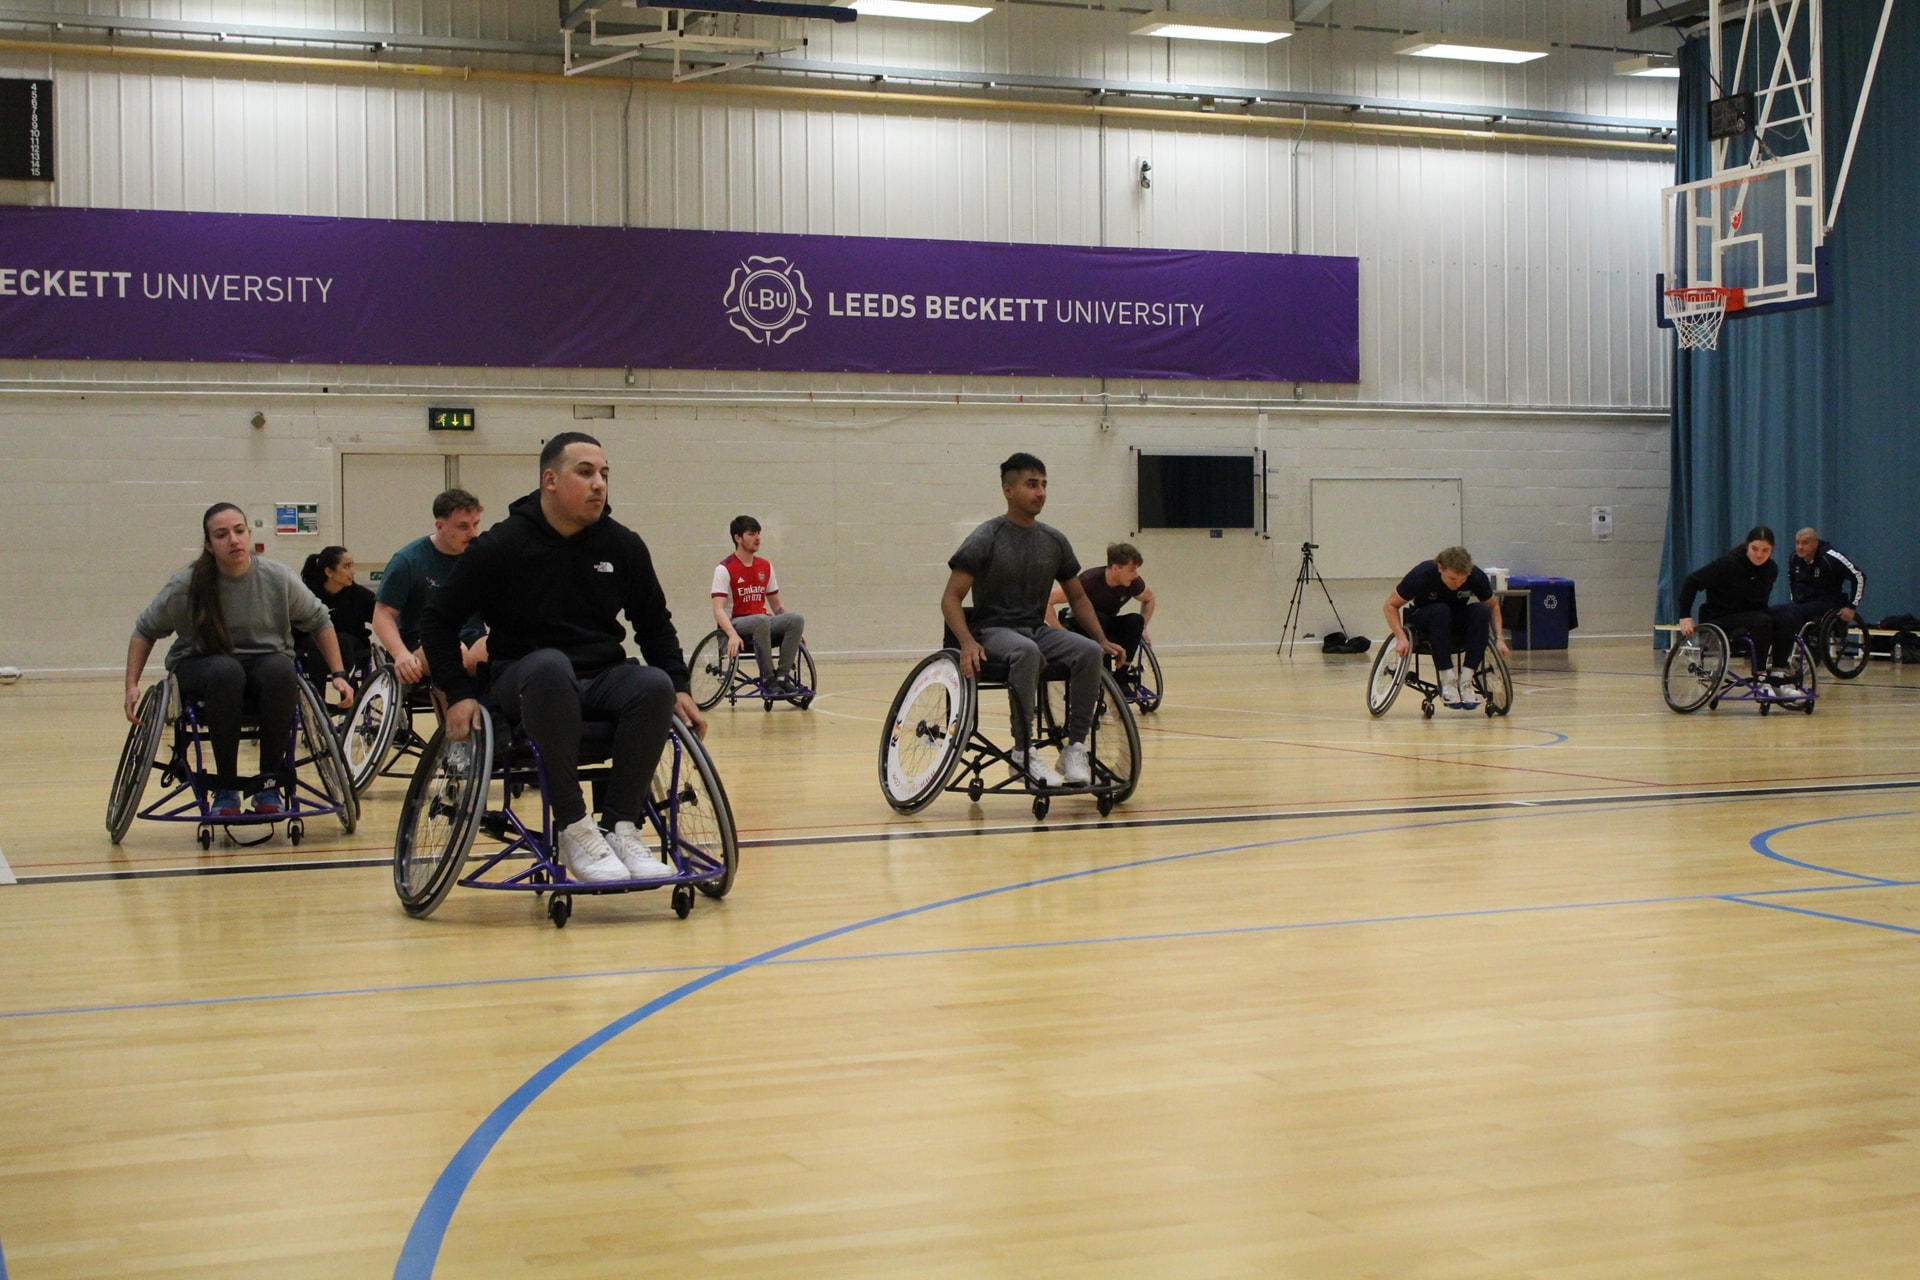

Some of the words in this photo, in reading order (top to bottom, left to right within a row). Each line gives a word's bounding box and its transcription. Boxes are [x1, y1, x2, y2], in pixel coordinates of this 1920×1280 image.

[31, 99, 38, 107] 6
[32, 114, 38, 122] 8
[30, 168, 40, 176] 15
[0, 268, 132, 298] ECKETT
[143, 272, 333, 303] UNIVERSITY
[748, 288, 788, 310] LBU
[828, 292, 917, 318] LEEDS
[925, 295, 1048, 322] BECKETT
[1056, 300, 1205, 326] UNIVERSITY
